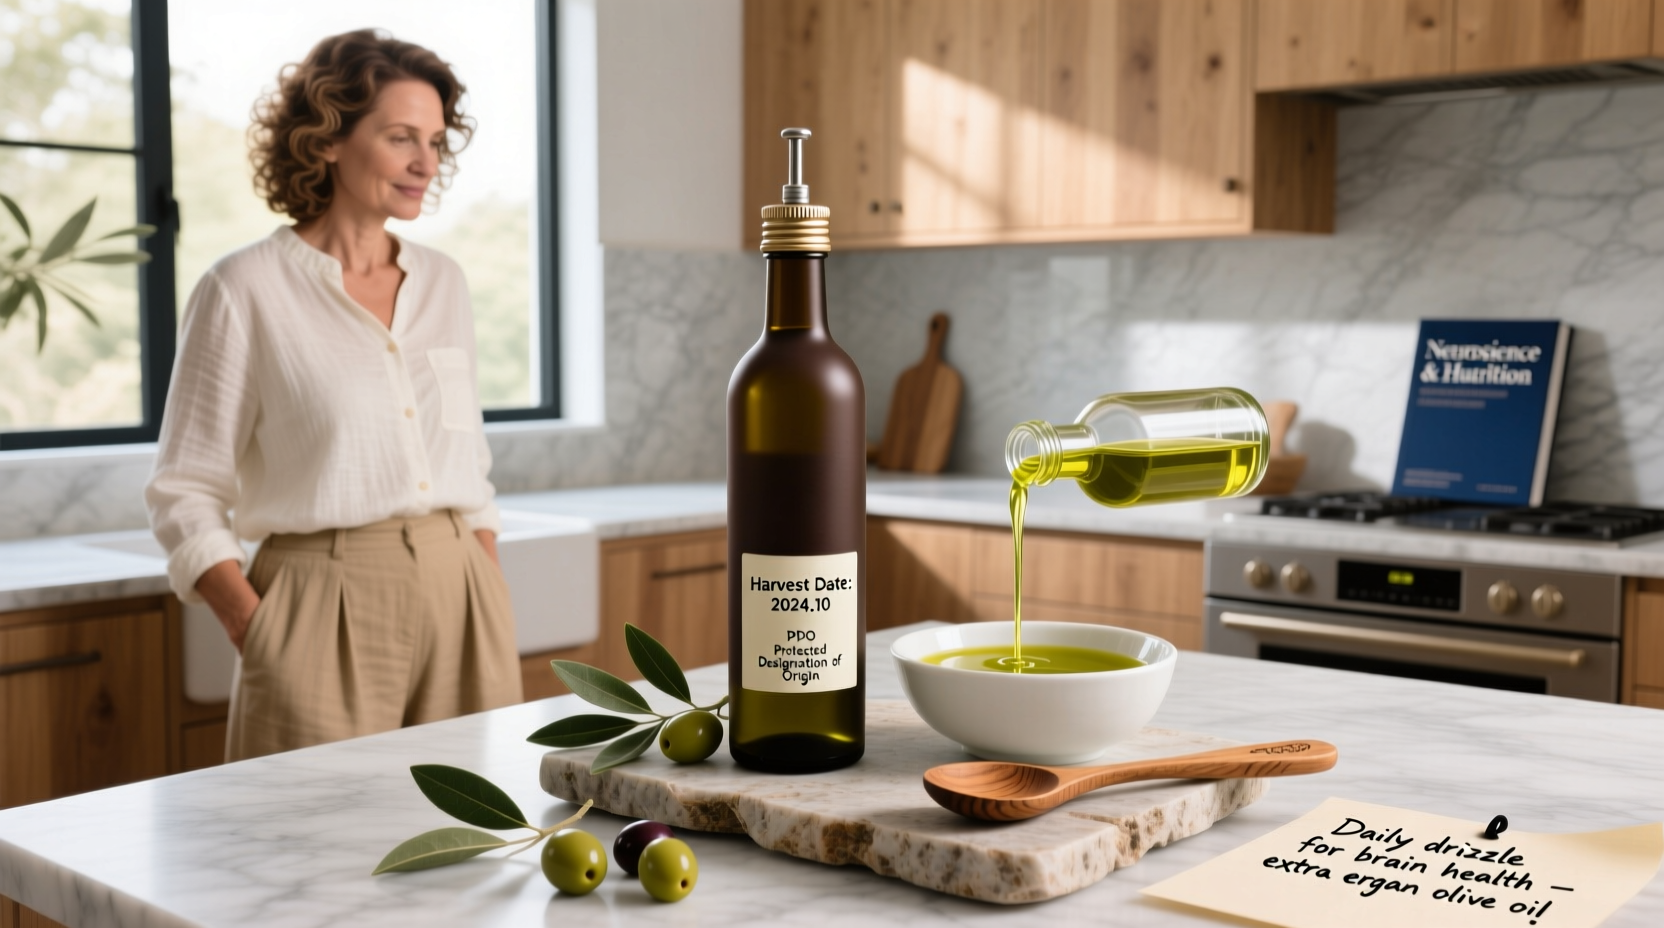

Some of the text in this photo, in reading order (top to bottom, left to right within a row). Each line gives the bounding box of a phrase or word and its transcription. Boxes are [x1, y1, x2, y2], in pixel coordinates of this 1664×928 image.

[1419, 361, 1440, 383] &
[750, 576, 852, 592] Harvest Date:
[770, 596, 831, 612] 2024.10
[786, 630, 816, 641] PDO
[774, 643, 827, 656] Protected
[832, 653, 842, 666] of
[1331, 817, 1525, 866] Daily drizzle
[1297, 836, 1345, 857] for
[1354, 846, 1428, 874] brain
[1440, 862, 1534, 891] health
[1262, 856, 1332, 880] extra
[1342, 872, 1419, 898] ergan
[1432, 885, 1497, 909] olive
